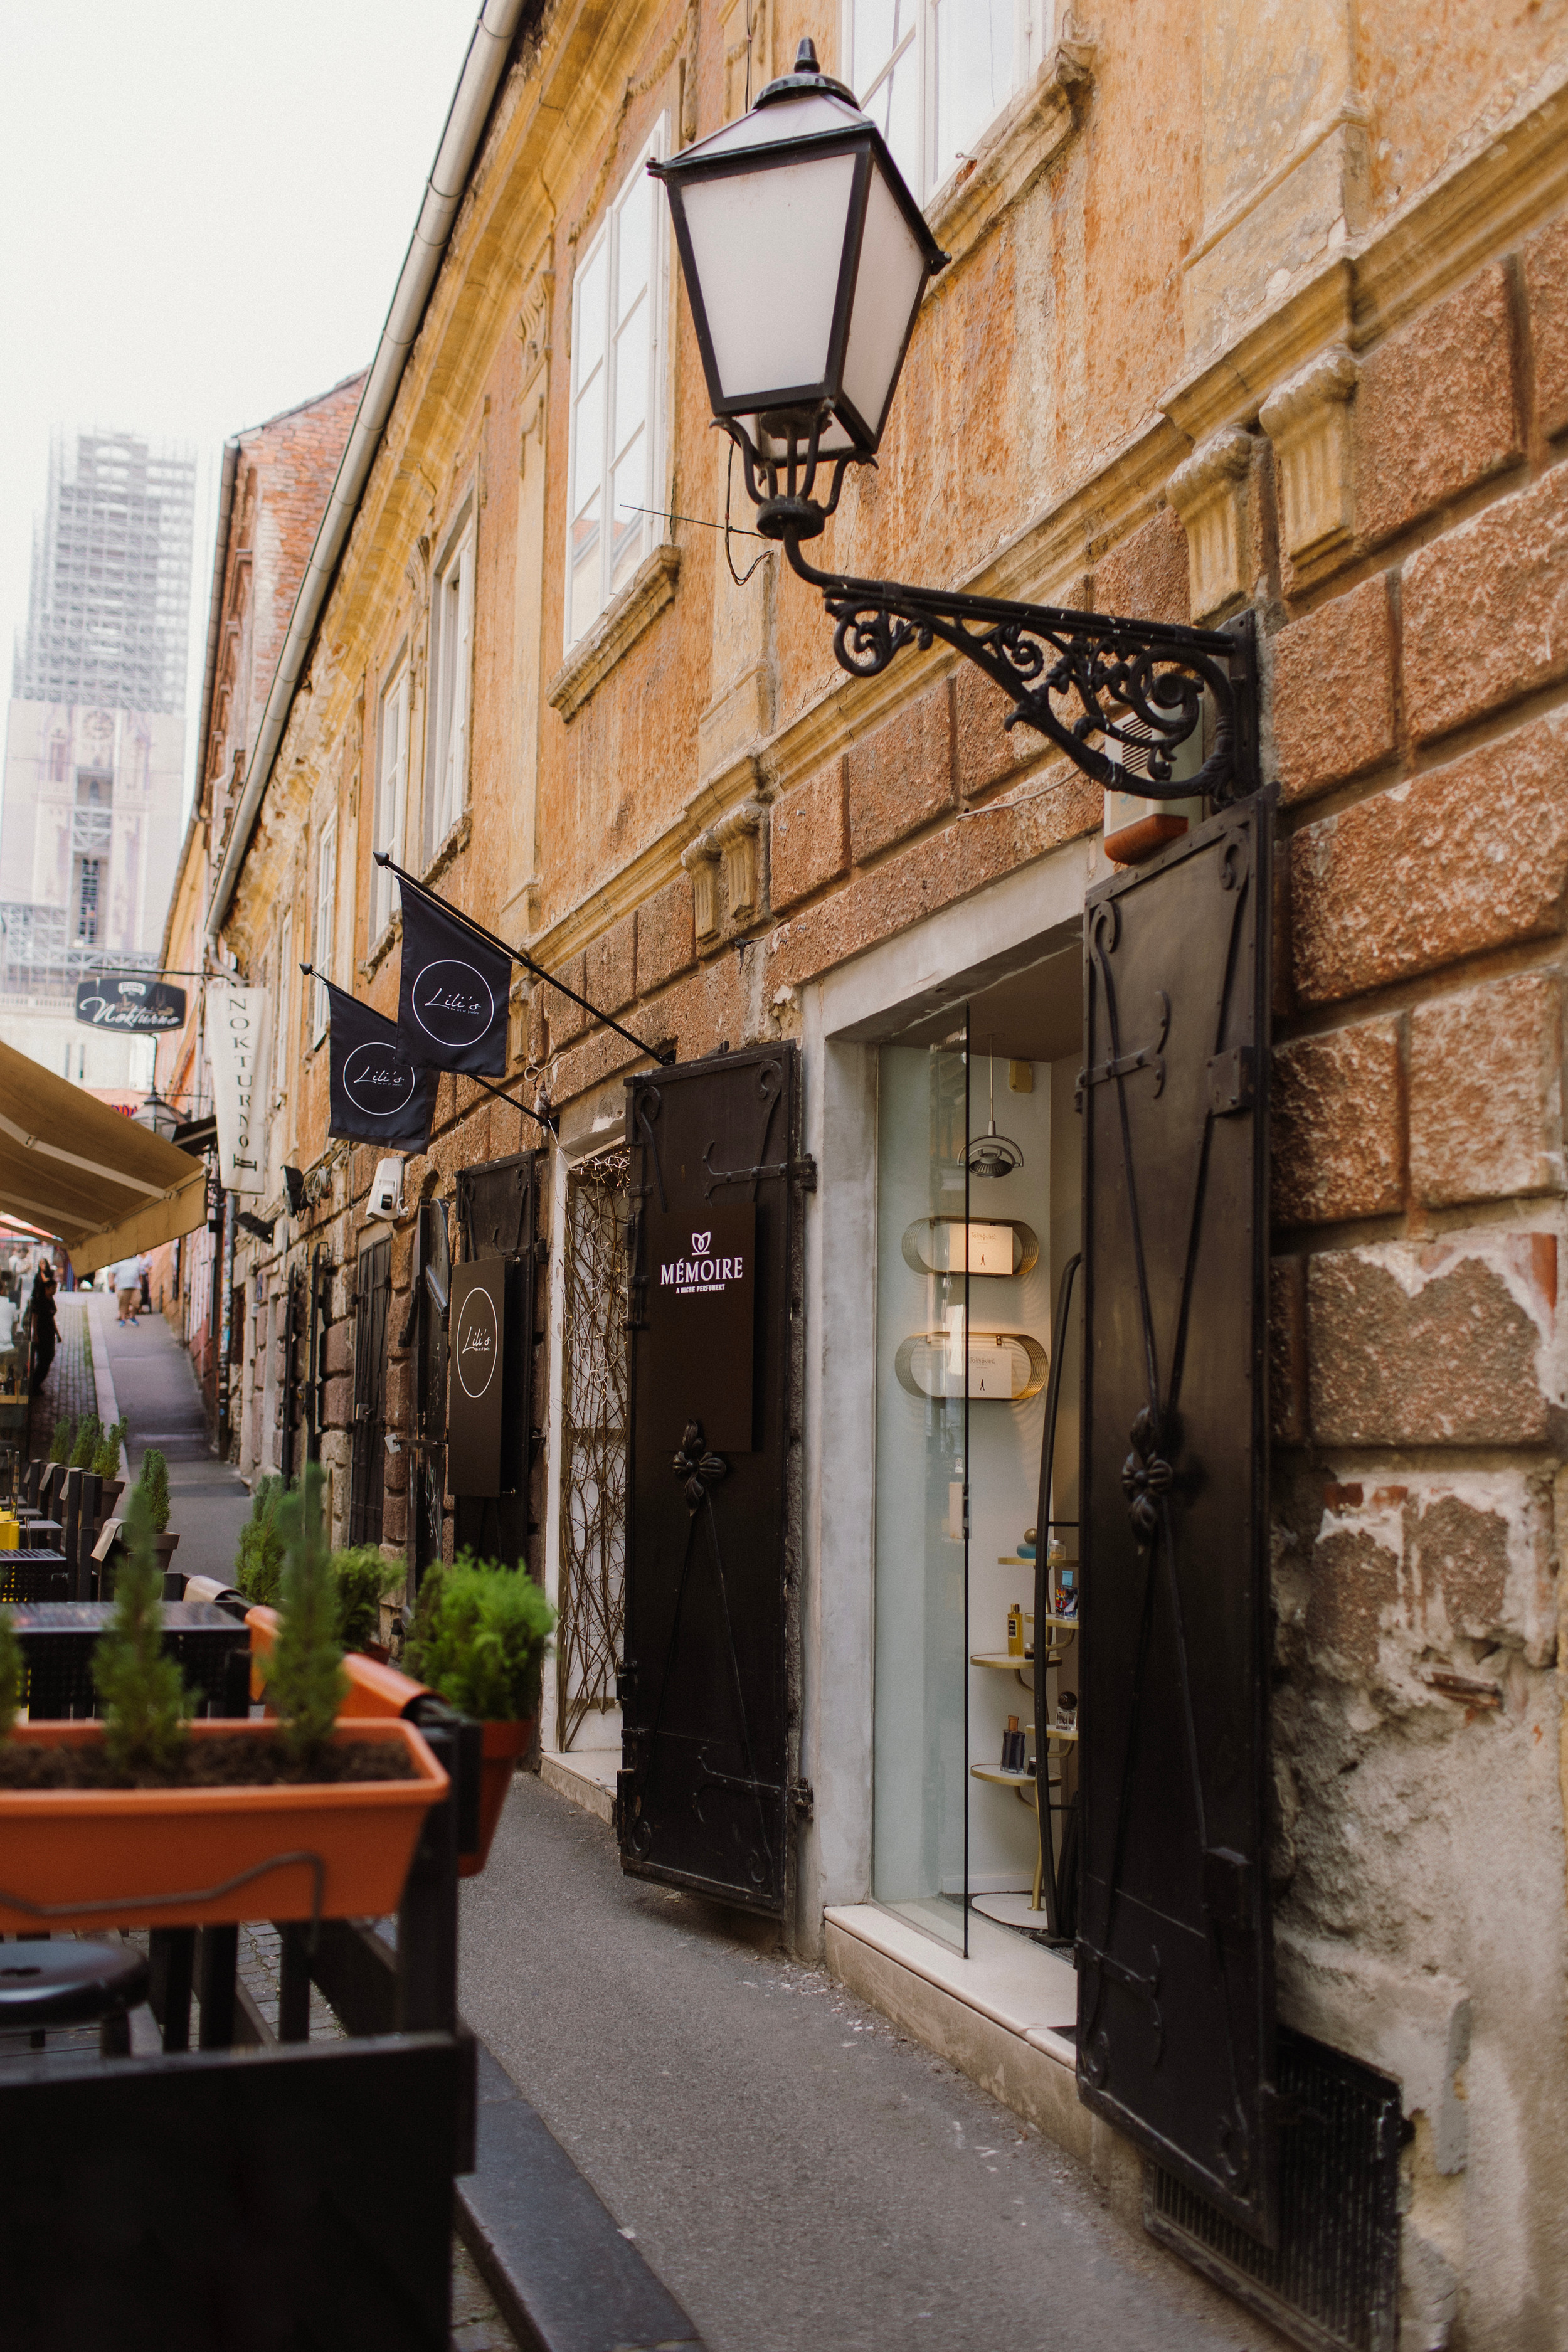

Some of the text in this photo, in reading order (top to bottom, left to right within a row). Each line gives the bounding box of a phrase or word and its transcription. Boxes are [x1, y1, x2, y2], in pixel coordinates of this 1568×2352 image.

[78, 996, 181, 1028] Nokturno
[424, 988, 482, 1010] Lili's
[228, 998, 253, 1148] NOKTURNO
[353, 1066, 405, 1084] Lili's
[660, 1256, 743, 1285] MÉMOIRE
[696, 1283, 726, 1292] PERFUMERY
[462, 1325, 492, 1354] Lili's
